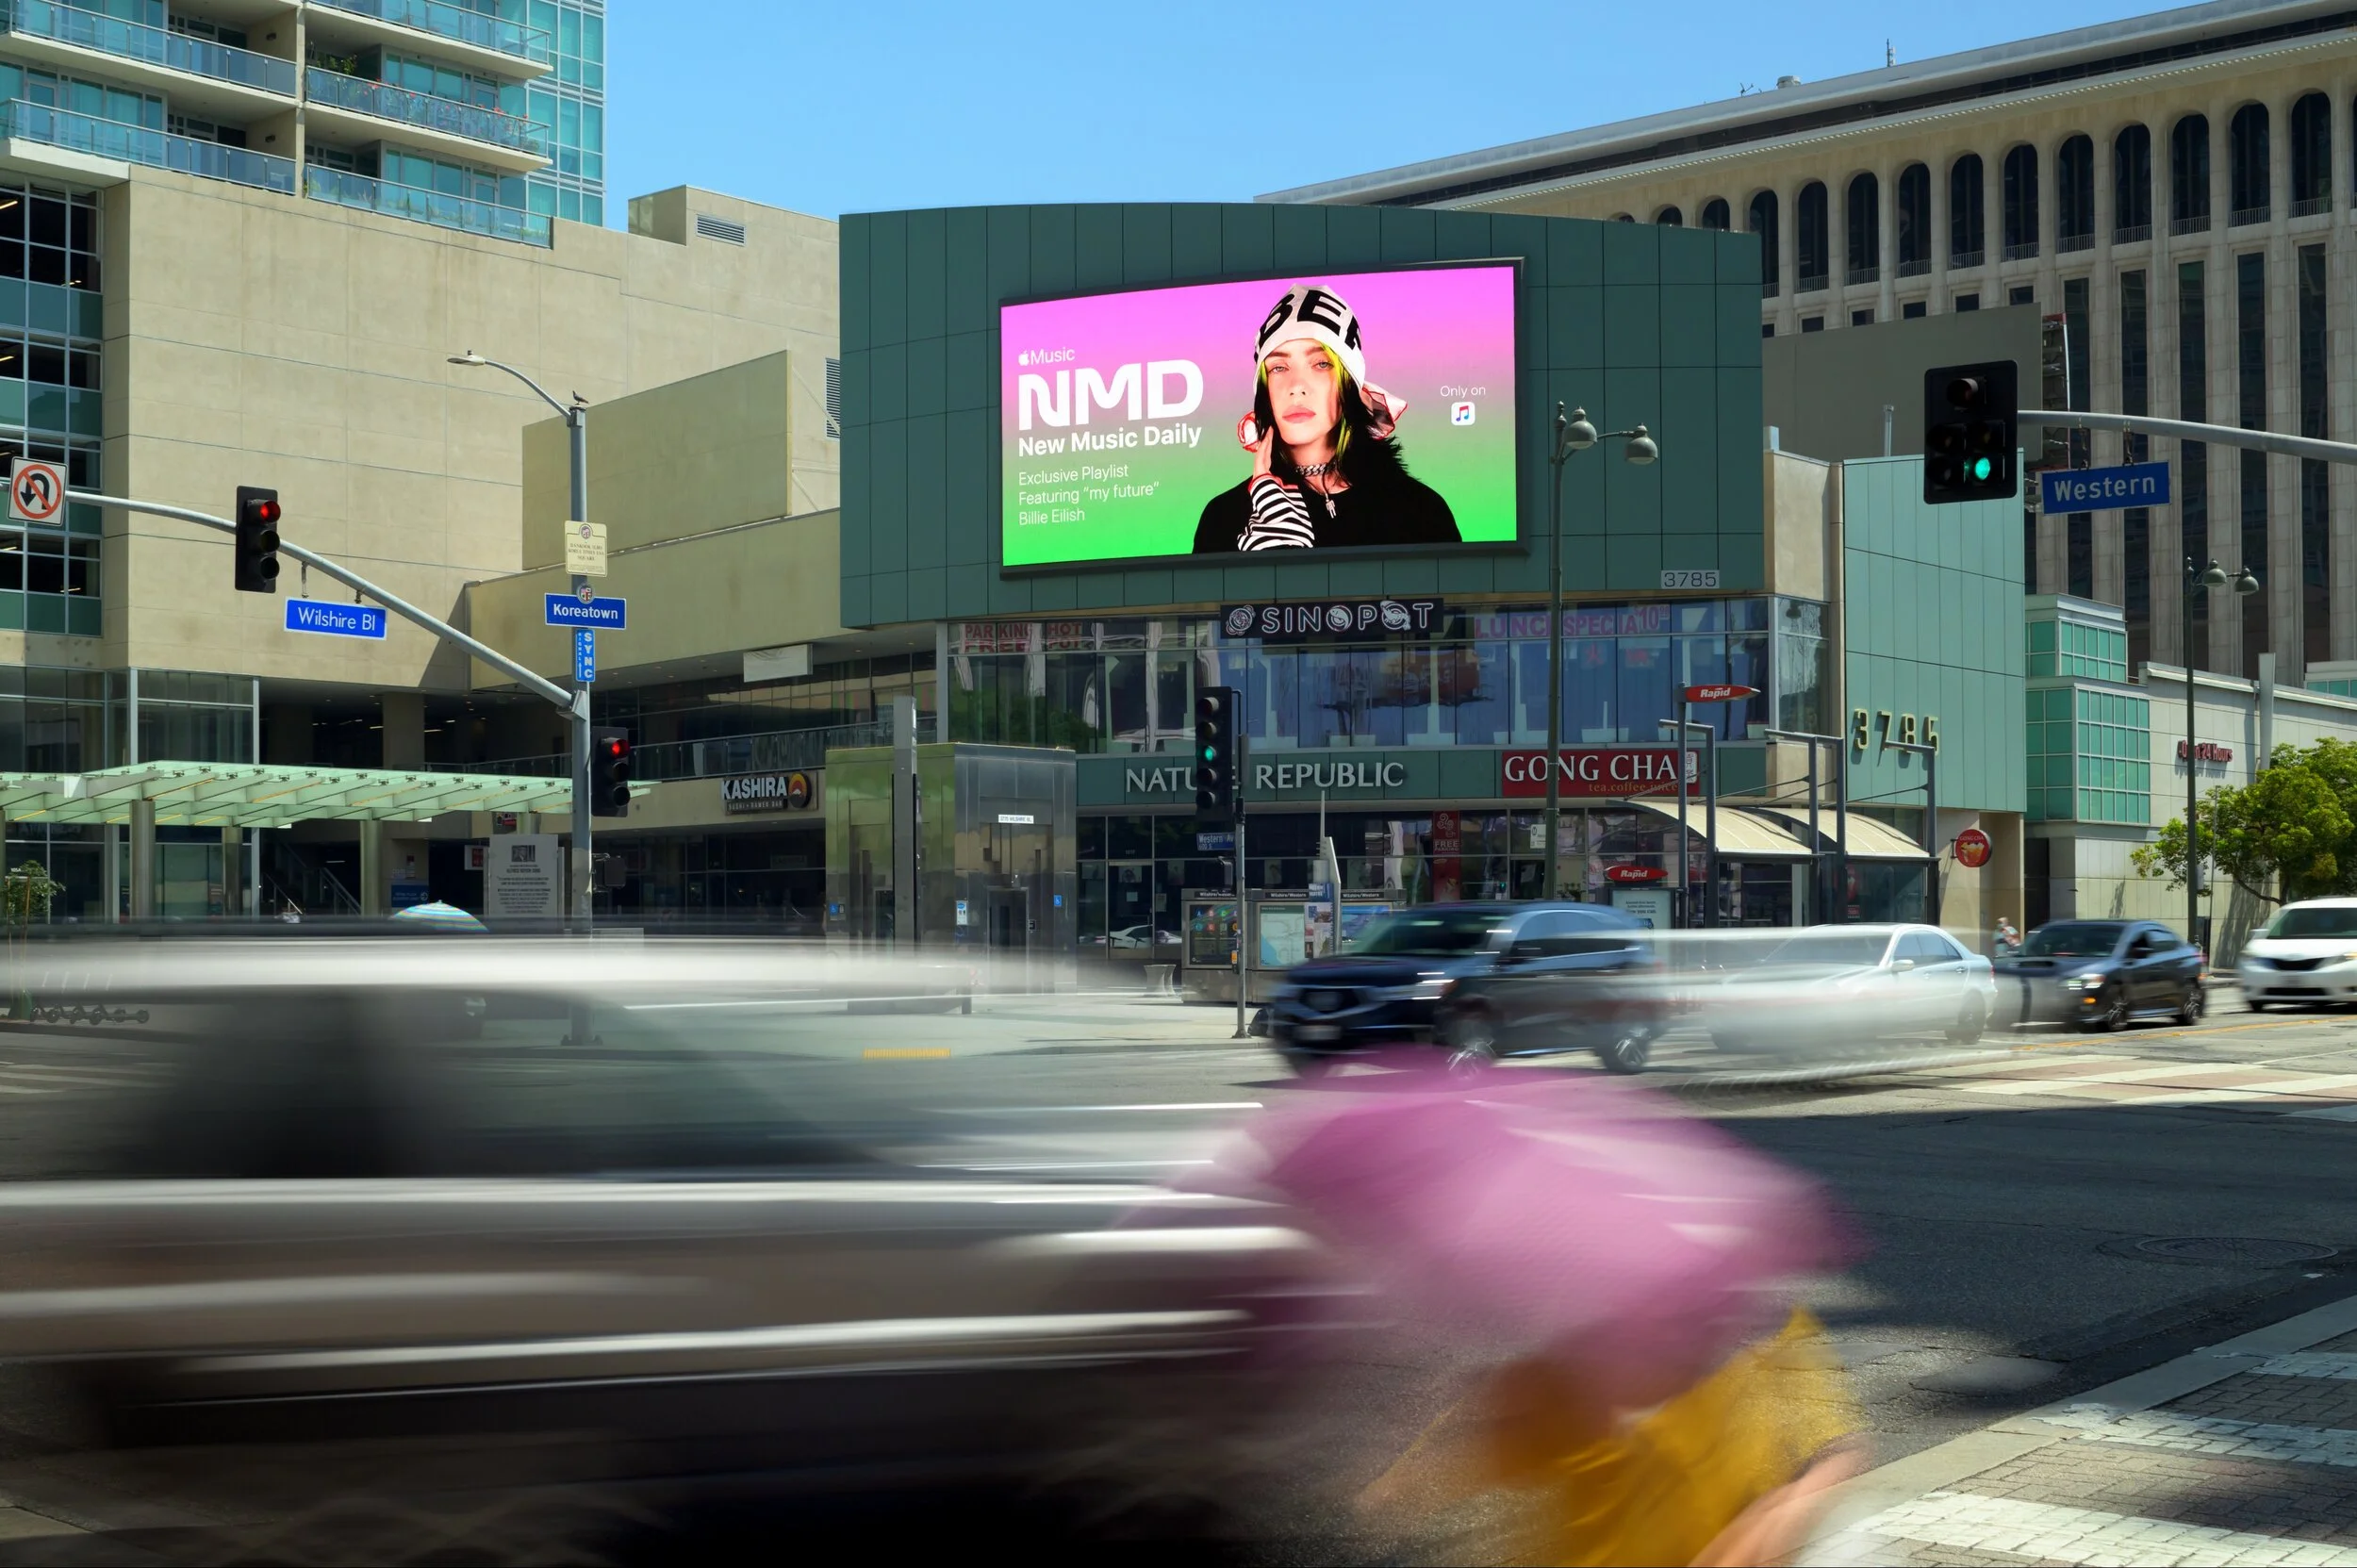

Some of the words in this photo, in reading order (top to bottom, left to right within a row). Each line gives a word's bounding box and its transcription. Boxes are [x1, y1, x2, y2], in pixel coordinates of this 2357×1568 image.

[1030, 347, 1076, 366] Music
[1018, 359, 1204, 431] NMD
[1440, 385, 1468, 399] Only
[1471, 387, 1486, 396] on
[1018, 436, 1066, 457] New
[1071, 426, 1138, 452] Music
[1144, 422, 1202, 448] Daily
[1018, 469, 1079, 486] Exclusive
[1081, 464, 1129, 482] Playlist
[1018, 488, 1080, 505] Featuring
[2053, 476, 2155, 503] Western
[1018, 510, 1048, 525] Billie
[1051, 507, 1085, 523] Eilish
[1663, 571, 1717, 588] 3785
[297, 606, 356, 630] Wilshire
[361, 613, 376, 631] Bl
[552, 602, 618, 619] Koreatown
[1261, 601, 1434, 634] SINOPOT
[1047, 622, 1082, 636] HOT
[584, 632, 593, 679] SYNC
[1700, 687, 1731, 699] Rapid
[1854, 708, 1939, 756] 3785
[2213, 743, 2233, 763] Hours
[1256, 762, 1404, 789] REPUBLIC
[1505, 755, 1600, 782] GONG
[1609, 754, 1677, 781] CHA
[721, 776, 788, 800] KASHIRA
[1198, 834, 1223, 843] Western
[1620, 869, 1648, 879] Rapid
